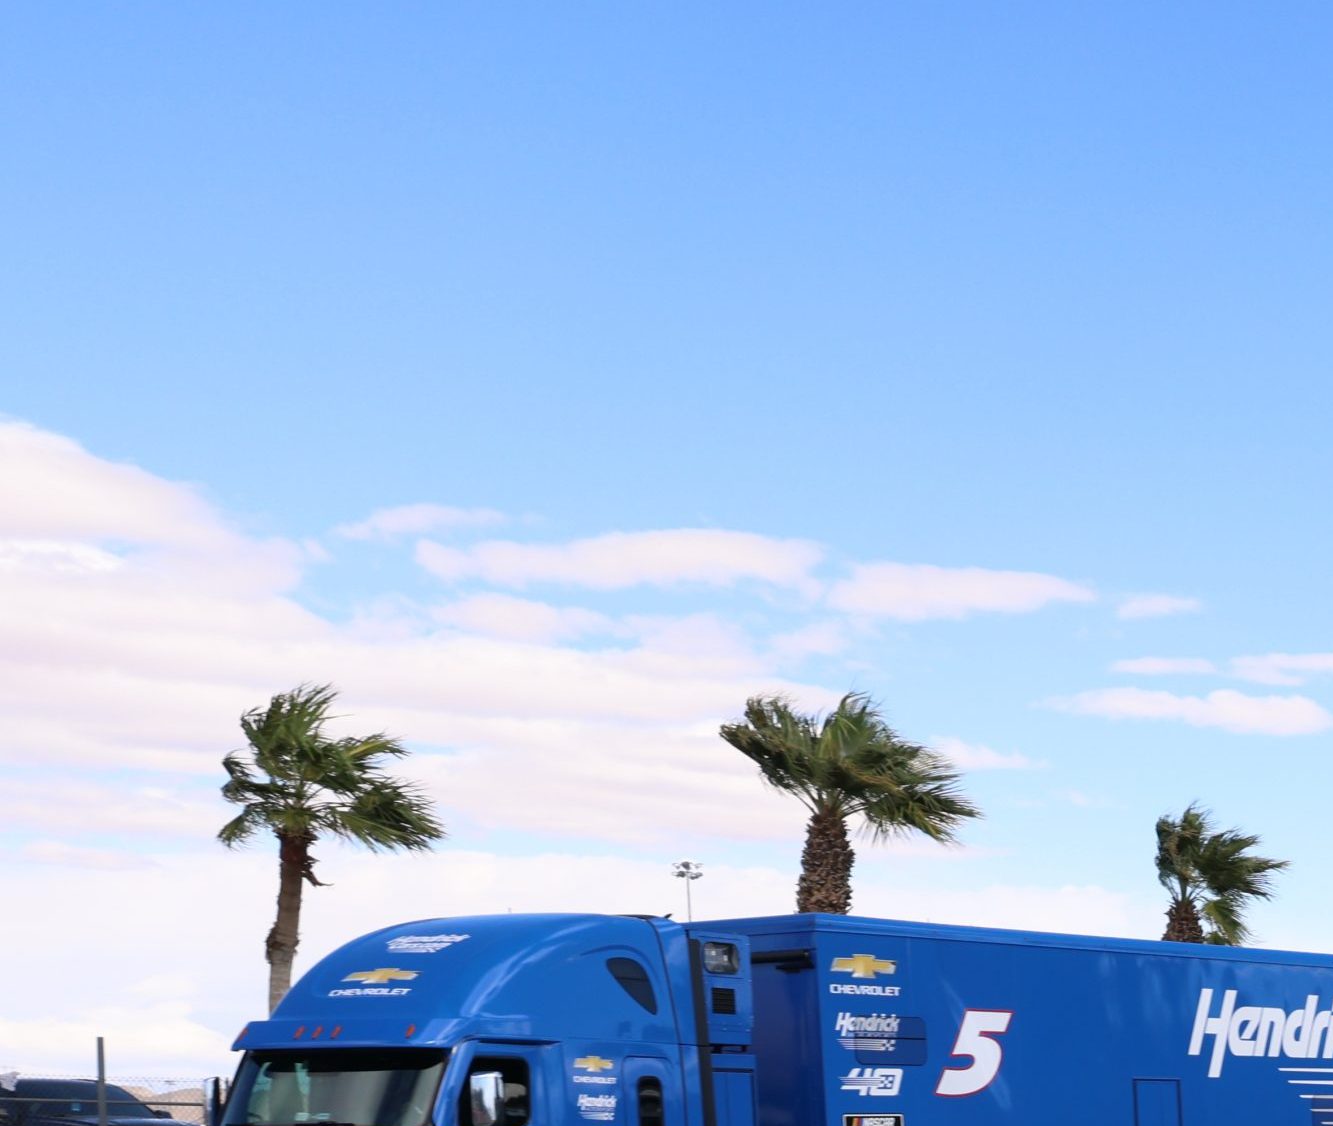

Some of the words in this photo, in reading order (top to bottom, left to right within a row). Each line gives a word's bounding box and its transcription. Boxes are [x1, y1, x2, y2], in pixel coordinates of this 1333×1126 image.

[328, 987, 413, 996] CHEVROLET
[829, 984, 901, 996] CHEVROLET
[835, 1012, 900, 1037] Hendrick
[935, 1008, 1014, 1098] 5
